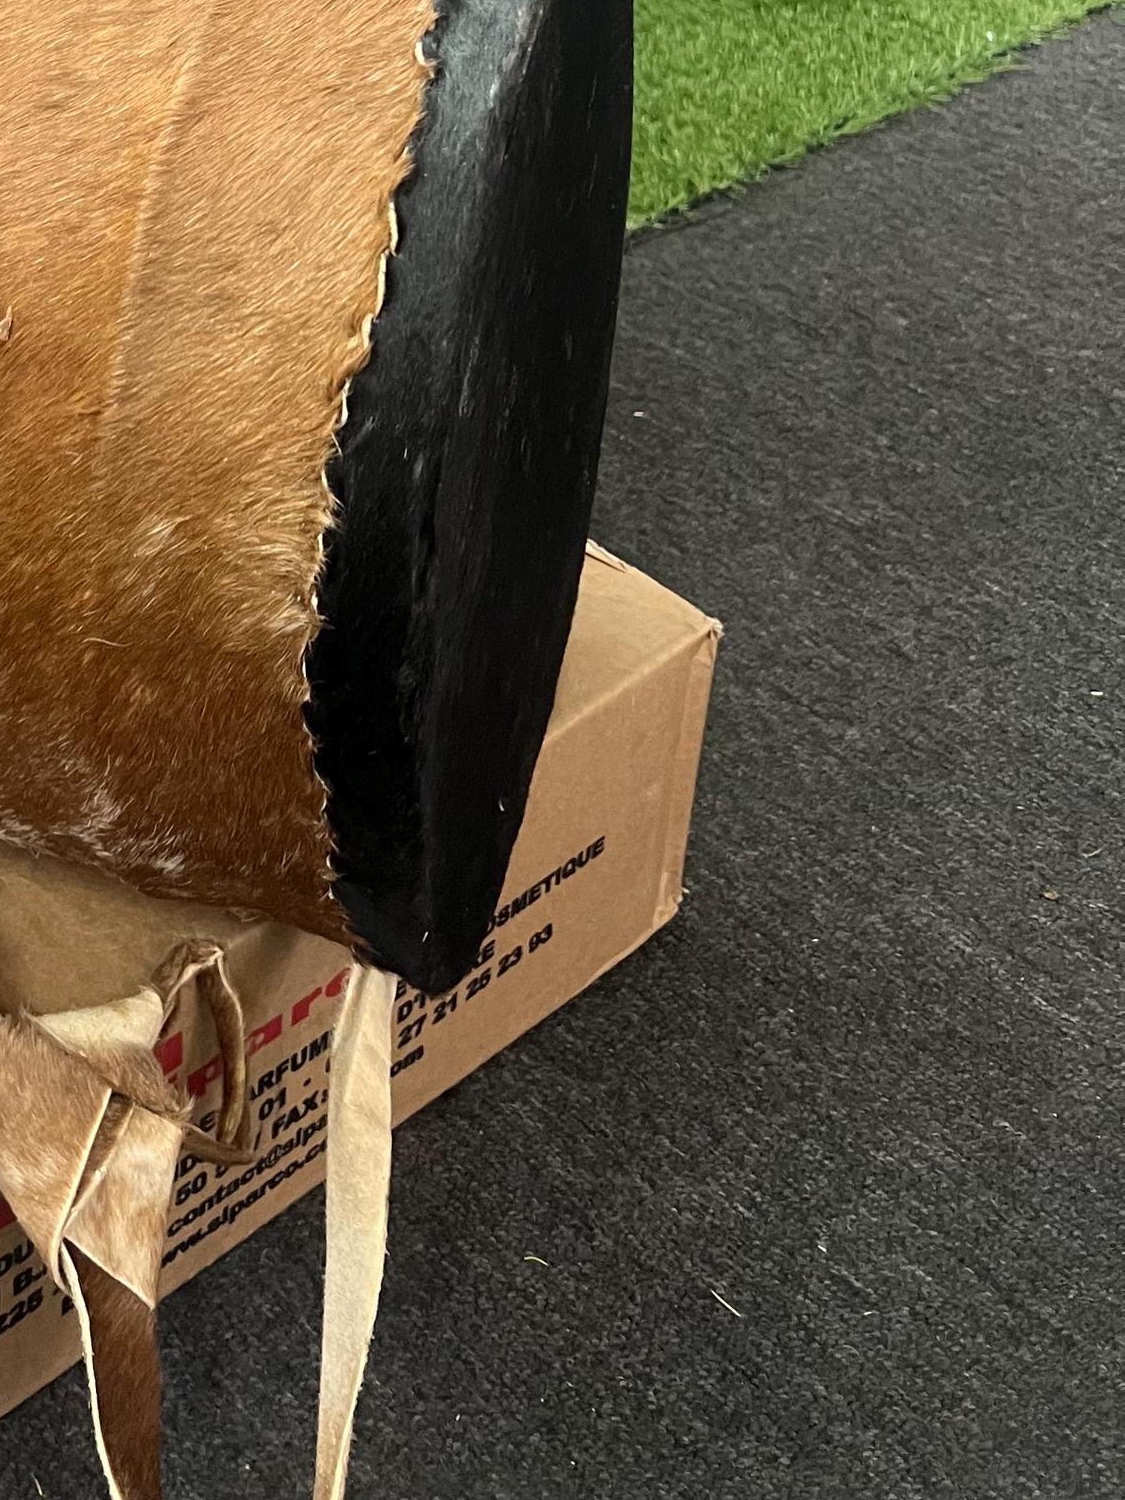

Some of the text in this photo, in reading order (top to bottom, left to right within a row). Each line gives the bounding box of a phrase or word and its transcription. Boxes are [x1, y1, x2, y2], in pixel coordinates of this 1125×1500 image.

[487, 835, 606, 932] SMETIQUE
[397, 1013, 428, 1049] 27
[432, 991, 458, 1025] 21
[258, 1087, 287, 1121] 01
